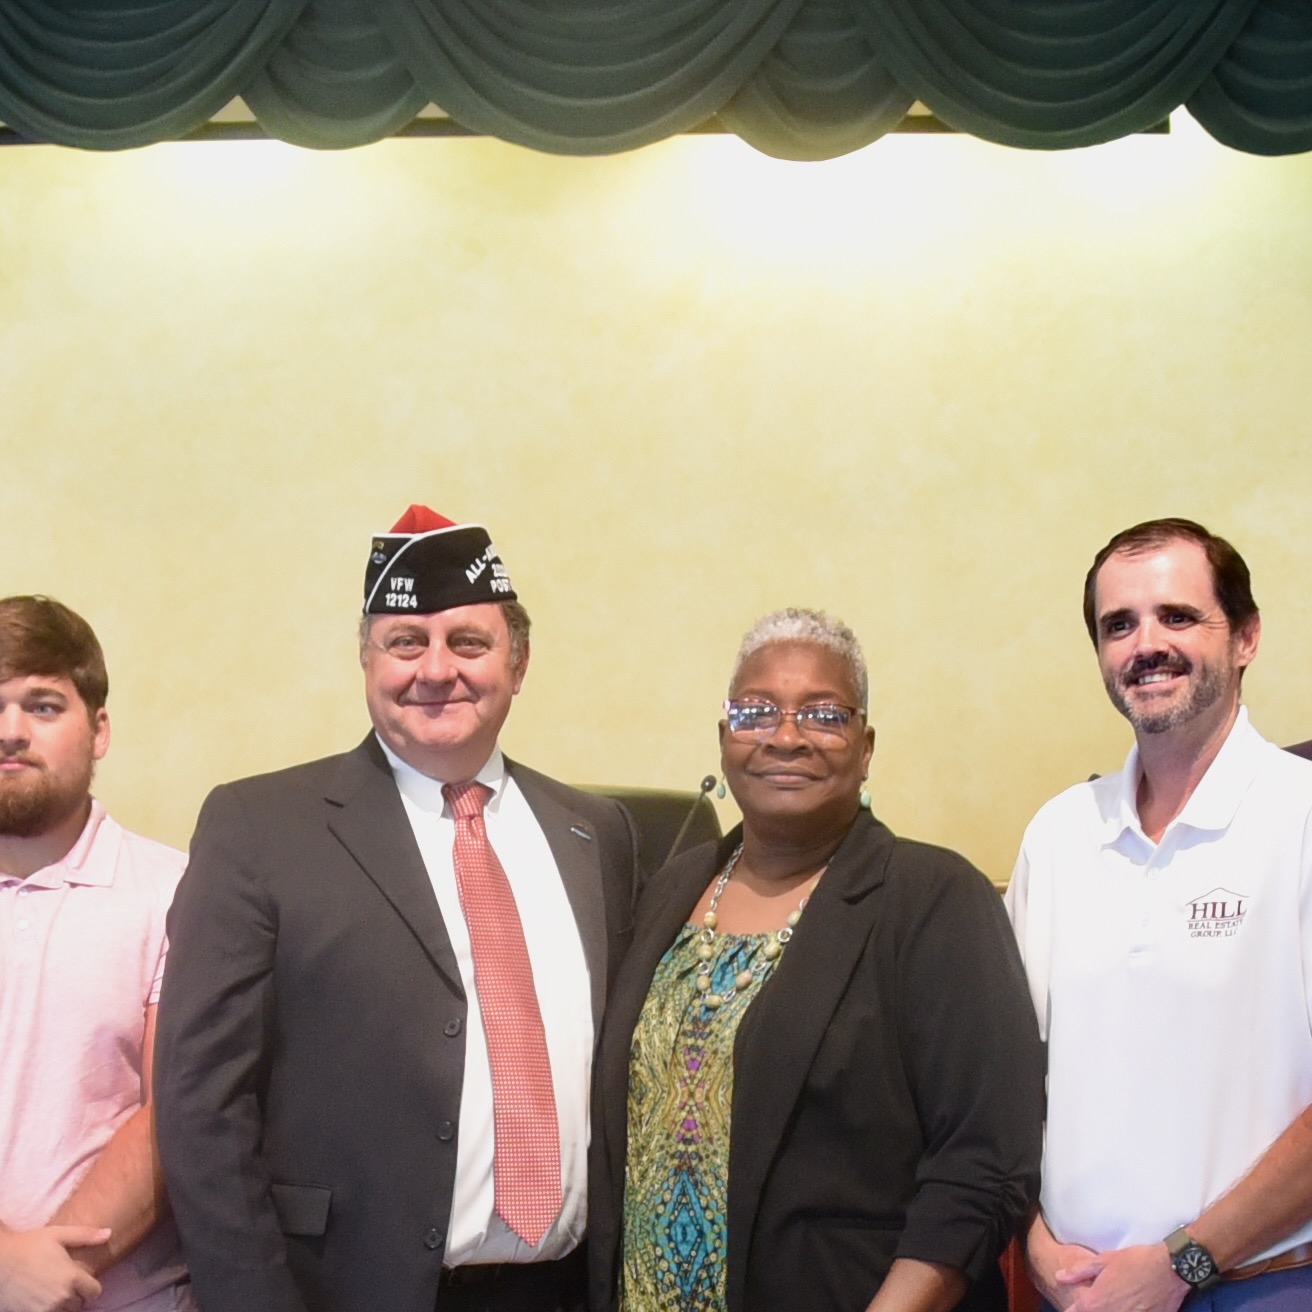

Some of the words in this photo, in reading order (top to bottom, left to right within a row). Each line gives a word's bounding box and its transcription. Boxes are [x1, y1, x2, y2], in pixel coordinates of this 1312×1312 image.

[390, 576, 415, 592] VFW
[384, 592, 418, 609] 12124
[1190, 899, 1248, 920] HILL
[1188, 921, 1213, 930] REAL
